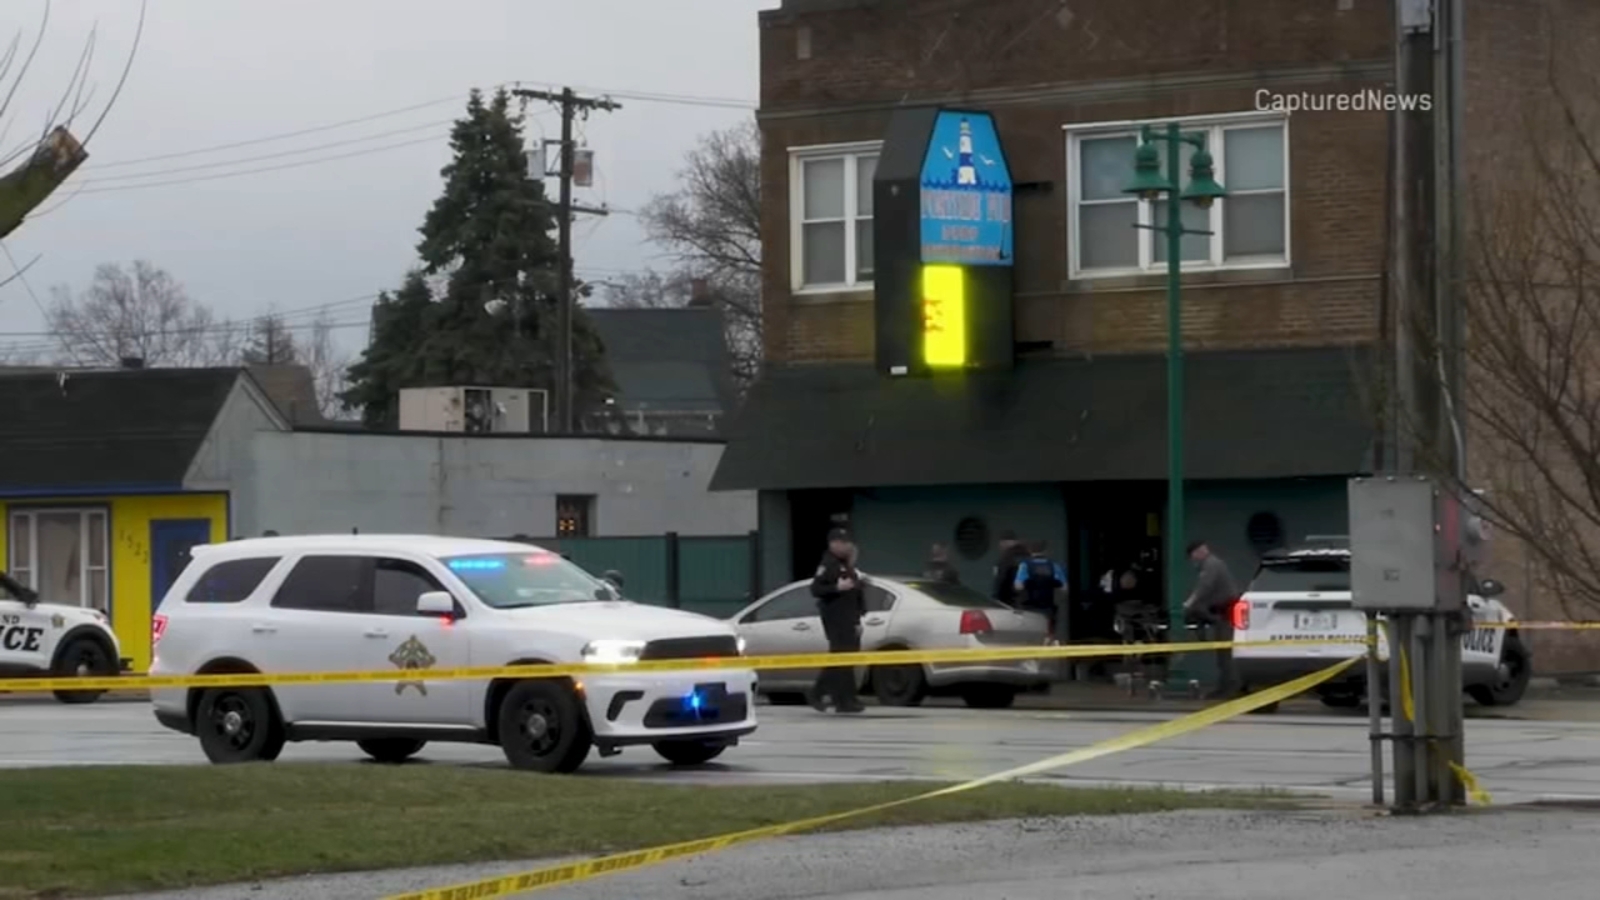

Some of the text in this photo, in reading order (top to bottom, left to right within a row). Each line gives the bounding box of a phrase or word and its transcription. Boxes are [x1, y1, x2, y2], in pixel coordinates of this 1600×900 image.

[3, 614, 21, 625] ND
[0, 625, 44, 651] CE
[1463, 627, 1496, 653] OLICE
